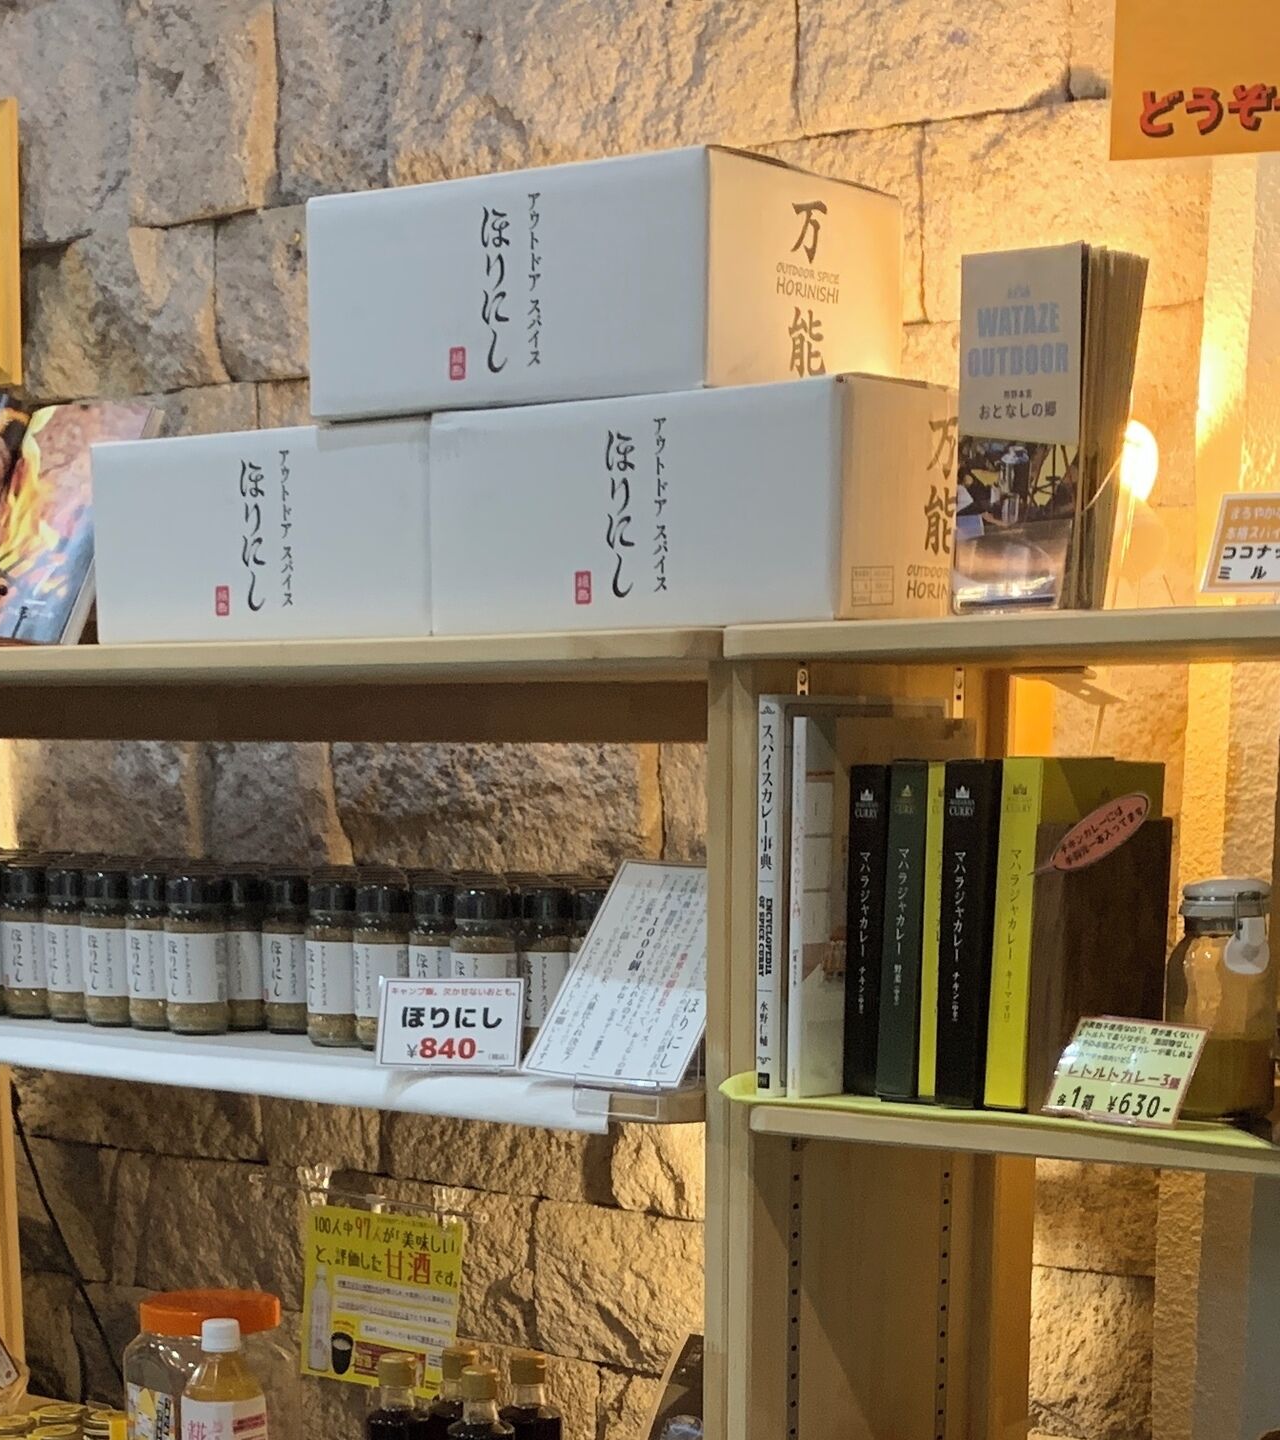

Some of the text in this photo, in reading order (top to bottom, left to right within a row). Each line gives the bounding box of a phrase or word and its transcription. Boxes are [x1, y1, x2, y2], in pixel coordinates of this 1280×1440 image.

[790, 200, 828, 264] 万
[776, 261, 814, 282] OUTDOOR
[480, 206, 511, 374] ほりにし
[775, 278, 840, 306] HORINISHI
[977, 303, 1060, 338] WATAZE
[968, 343, 1069, 377] OUTDOOR
[979, 402, 1056, 419] おとなしの郷
[604, 430, 635, 599] ほりにし
[239, 460, 266, 611] ほりにし
[951, 850, 968, 964] マハラジャカレー
[401, 1006, 503, 1029] ほりにし
[1108, 1092, 1171, 1118] ¥630-
